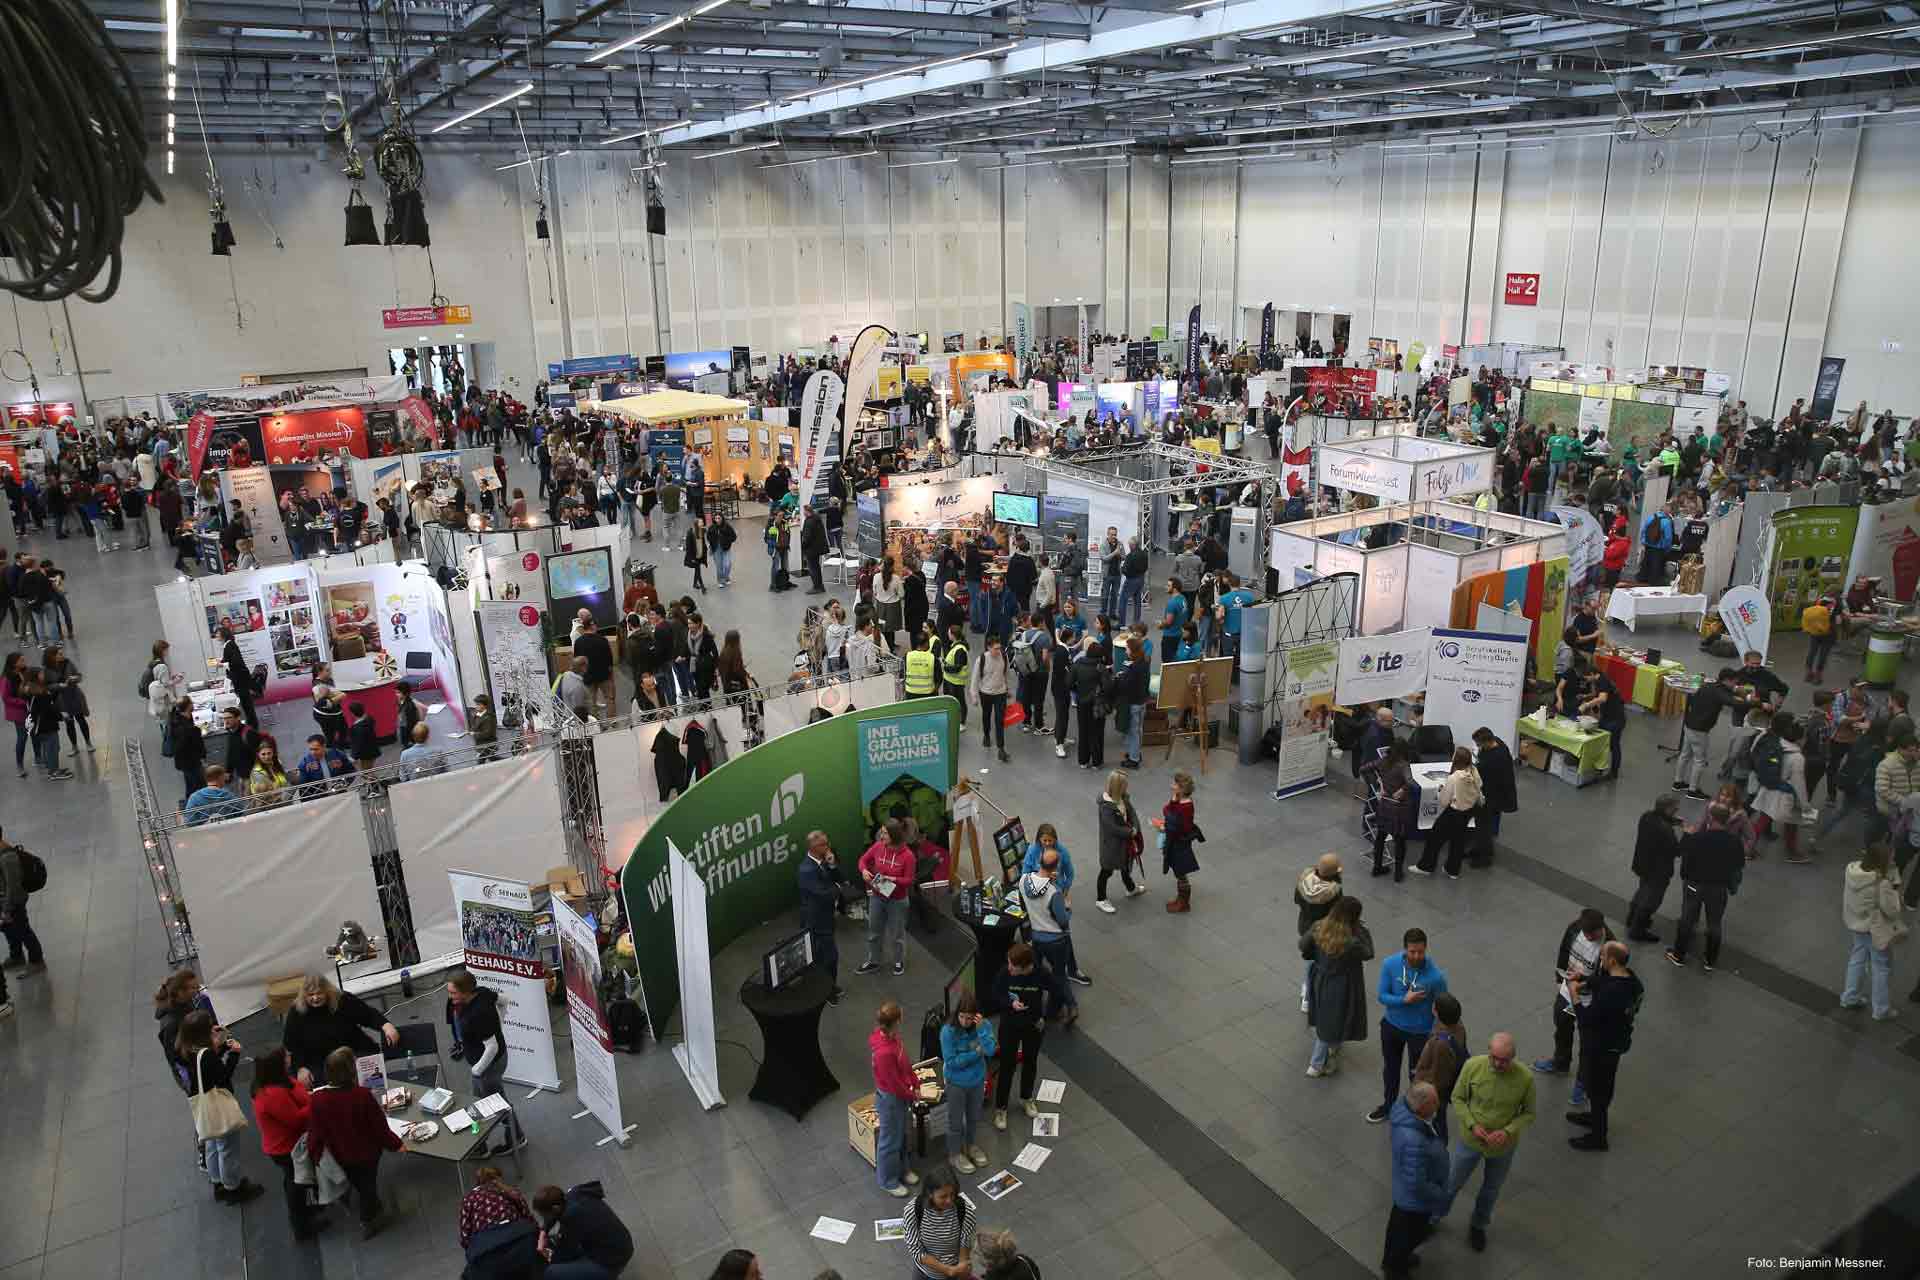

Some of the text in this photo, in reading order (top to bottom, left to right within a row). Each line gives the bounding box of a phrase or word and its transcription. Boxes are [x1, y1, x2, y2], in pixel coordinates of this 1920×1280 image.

[1525, 277, 1536, 295] 2
[316, 430, 342, 440] Mission
[803, 375, 830, 480] helimission
[868, 726, 899, 739] INTE
[868, 732, 939, 752] GRATIVES
[870, 743, 940, 764] WOHNEN
[706, 834, 798, 897] ffnung.
[466, 954, 538, 977] SEEHAUS E.V.
